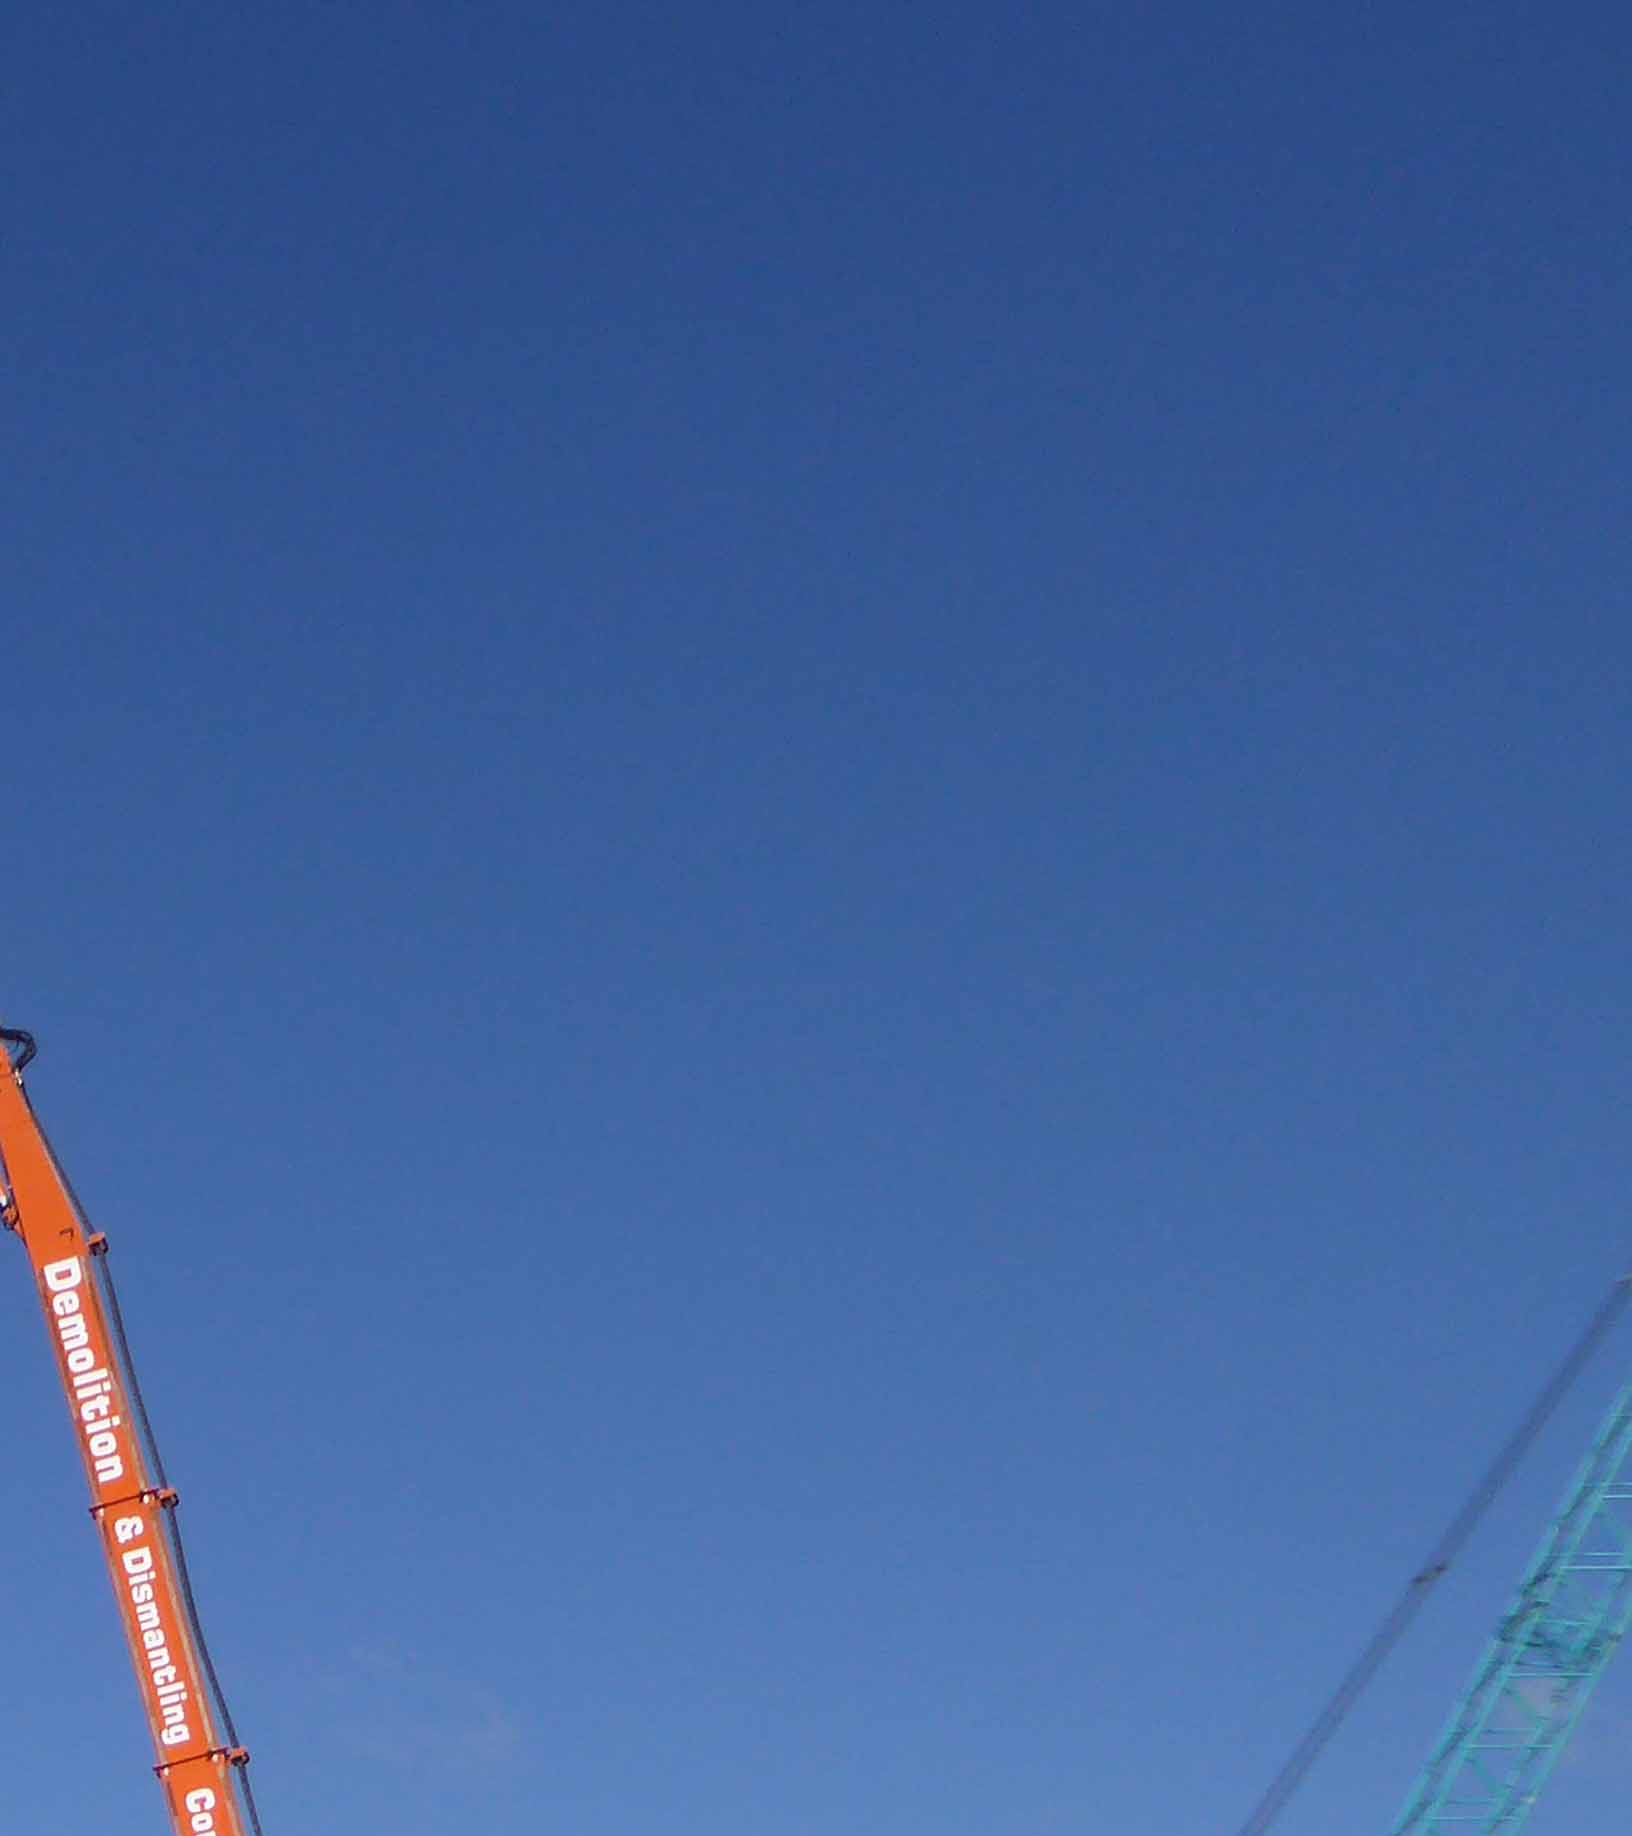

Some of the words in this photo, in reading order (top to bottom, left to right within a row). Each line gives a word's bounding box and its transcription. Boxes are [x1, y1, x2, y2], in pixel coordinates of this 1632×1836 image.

[42, 1256, 123, 1483] Demolition
[114, 1515, 144, 1544] &
[122, 1546, 190, 1746] Dismantling
